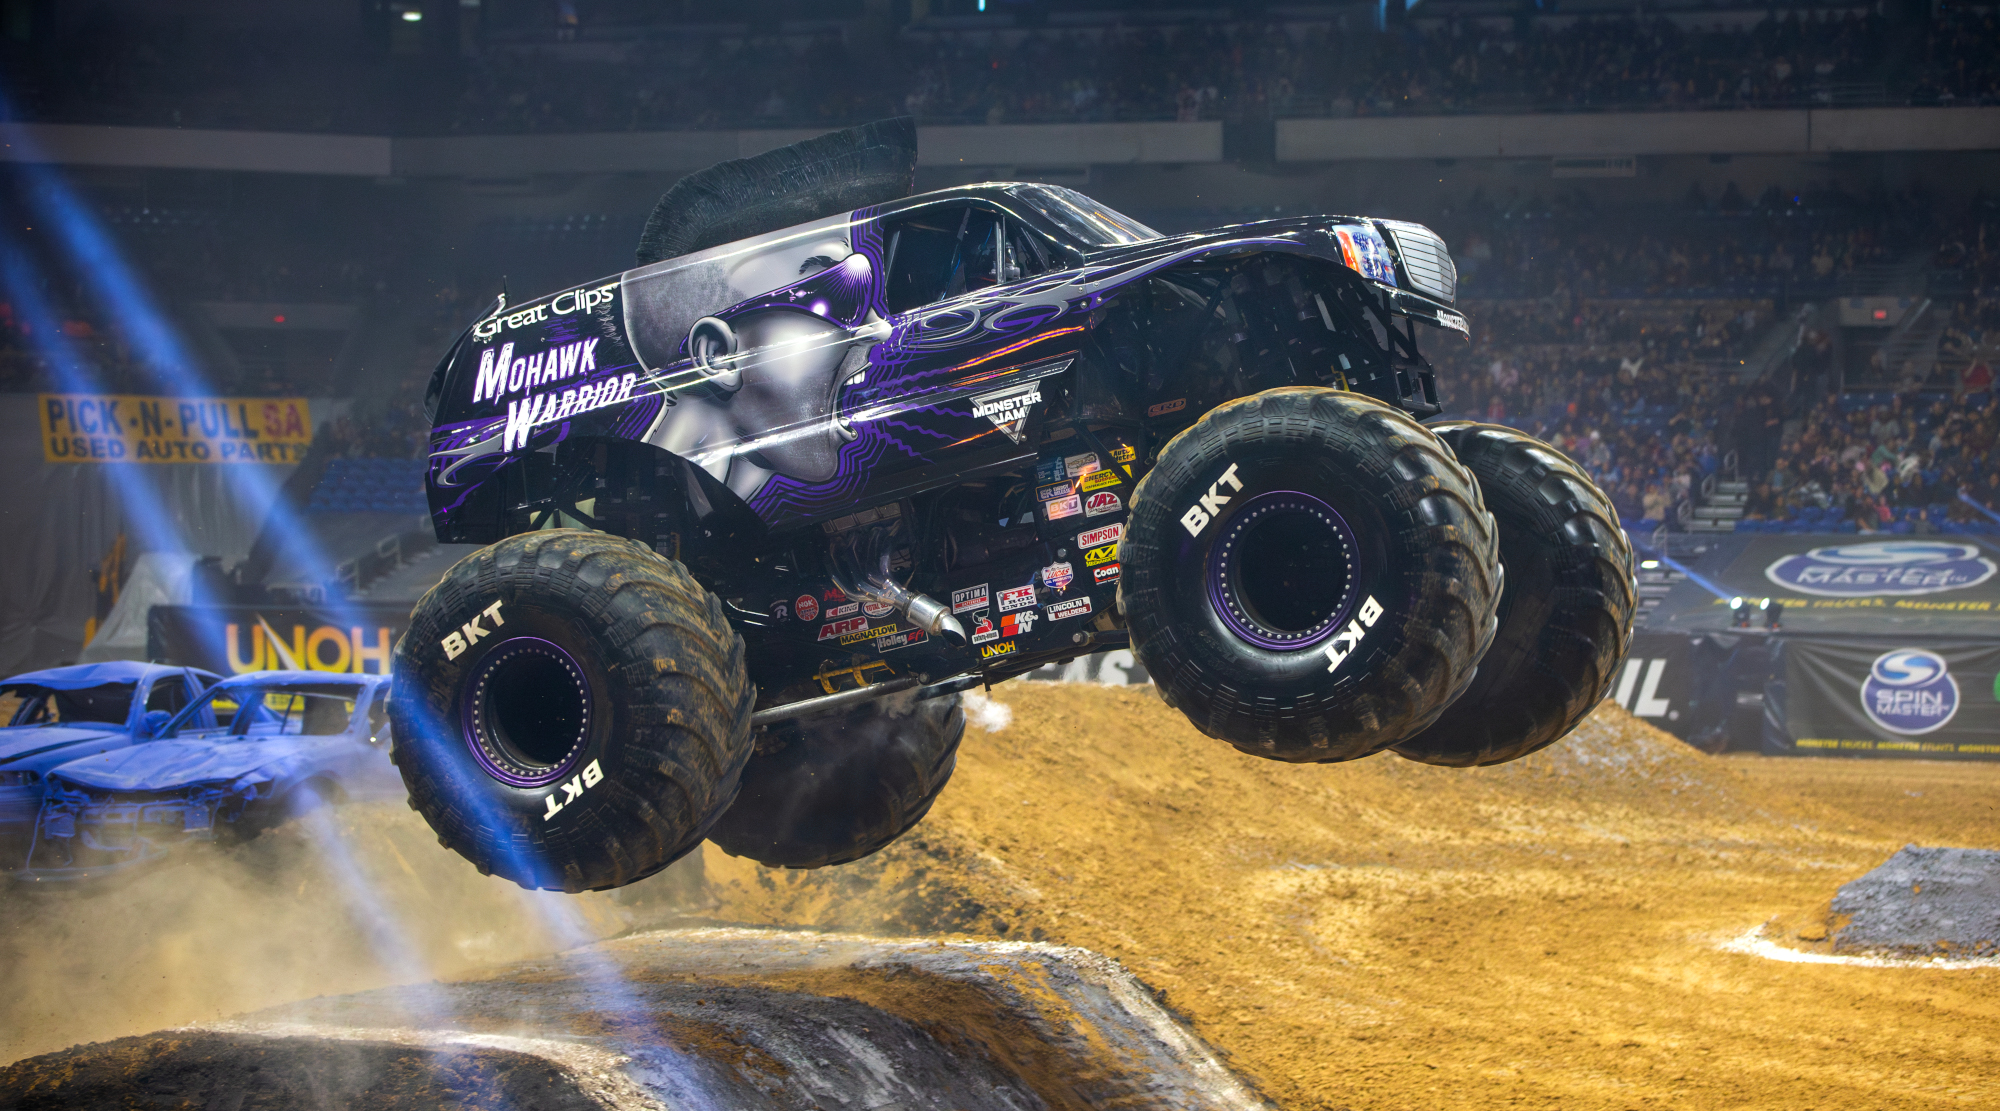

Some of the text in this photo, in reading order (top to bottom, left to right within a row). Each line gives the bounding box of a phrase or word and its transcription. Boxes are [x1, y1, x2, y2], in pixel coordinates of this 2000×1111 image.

[473, 284, 615, 339] Great Clips
[473, 337, 599, 404] MOHAWK
[503, 372, 636, 453] WARRIOR
[972, 391, 1042, 419] MONSTER
[263, 402, 304, 438] SA
[994, 407, 1026, 425] JAM
[51, 437, 126, 460] USED
[136, 440, 211, 460] AUTO
[1049, 497, 1078, 514] BKT
[1087, 493, 1118, 509] JAZ
[1180, 462, 1244, 538] BKT
[1082, 526, 1119, 546] SIMPSON
[1047, 568, 1070, 579] LUCAS
[1094, 566, 1119, 578] Coan
[798, 599, 814, 609] NGK
[955, 587, 986, 603] OPTIMA
[1008, 596, 1034, 605] ROD
[838, 604, 858, 614] KING
[1001, 600, 1035, 611] ENDS
[1049, 600, 1083, 613] LINCOLN
[1057, 606, 1088, 618] WELDERS
[441, 599, 505, 661] BKT
[819, 616, 867, 639] ARP
[841, 624, 896, 644] MAGNAFLOW
[1324, 594, 1384, 673] BKT
[226, 614, 391, 675] UNOH
[879, 634, 908, 648] Holley
[981, 640, 1016, 658] UNOH
[1875, 688, 1943, 705] SPIN
[1875, 702, 1944, 717] MASTER
[543, 758, 605, 822] BKT
